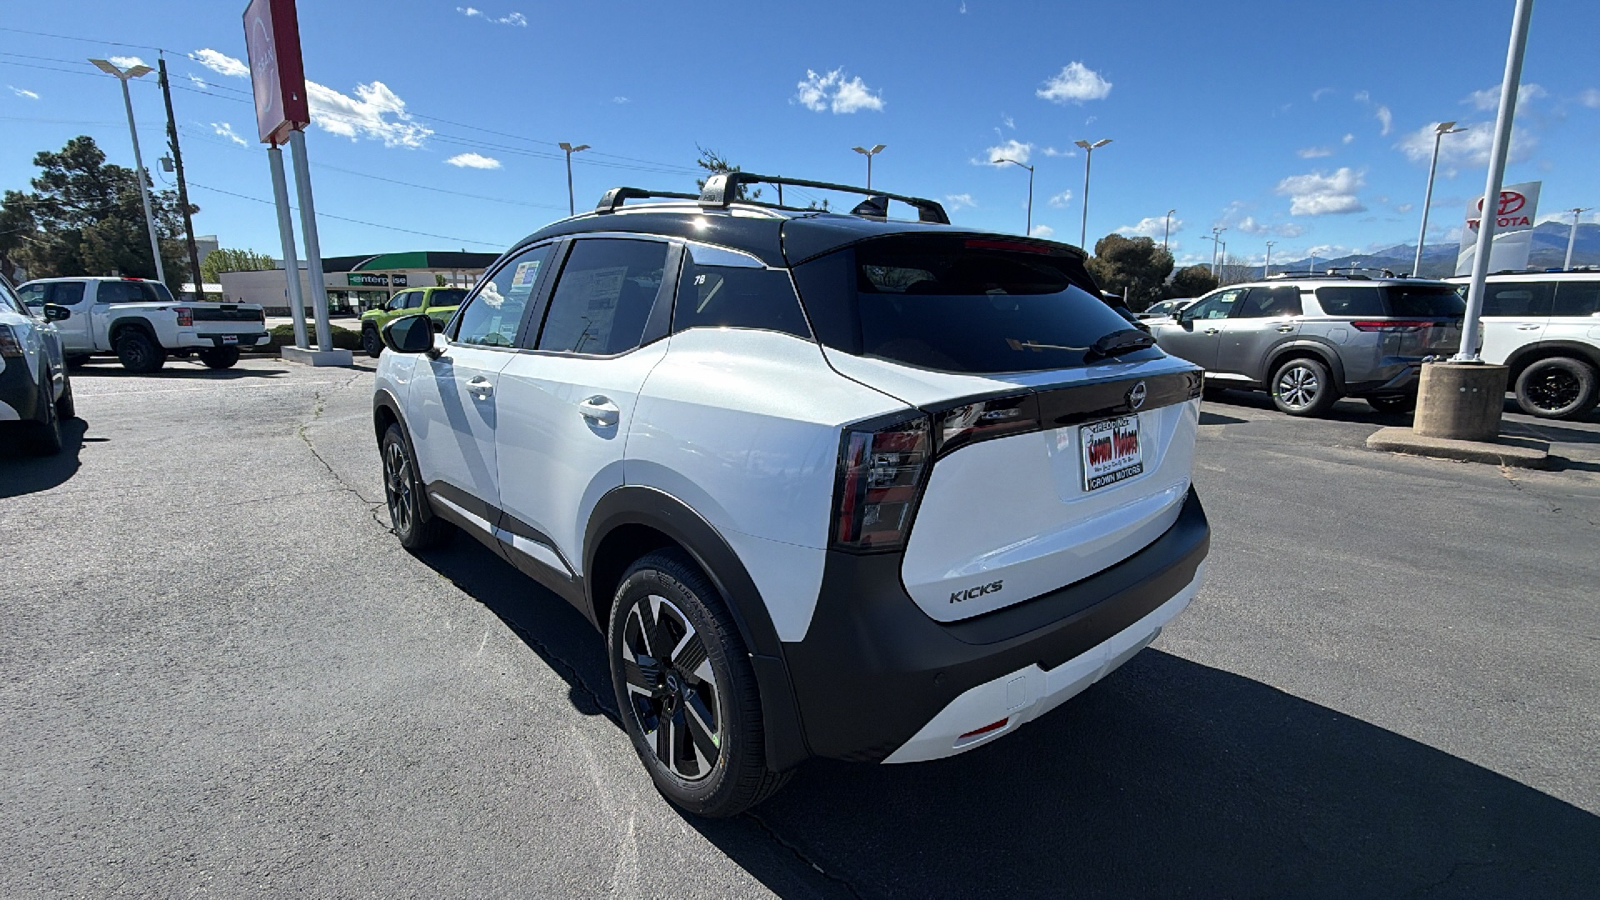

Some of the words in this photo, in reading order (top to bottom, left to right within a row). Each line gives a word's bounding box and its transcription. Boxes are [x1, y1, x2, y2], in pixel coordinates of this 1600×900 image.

[1467, 216, 1530, 230] TOTA
[350, 276, 406, 285] enterpise
[1097, 417, 1128, 431] REDDING
[1091, 473, 1115, 489] CROWN
[1116, 465, 1141, 481] MOTORS
[949, 579, 1004, 604] KICKS
